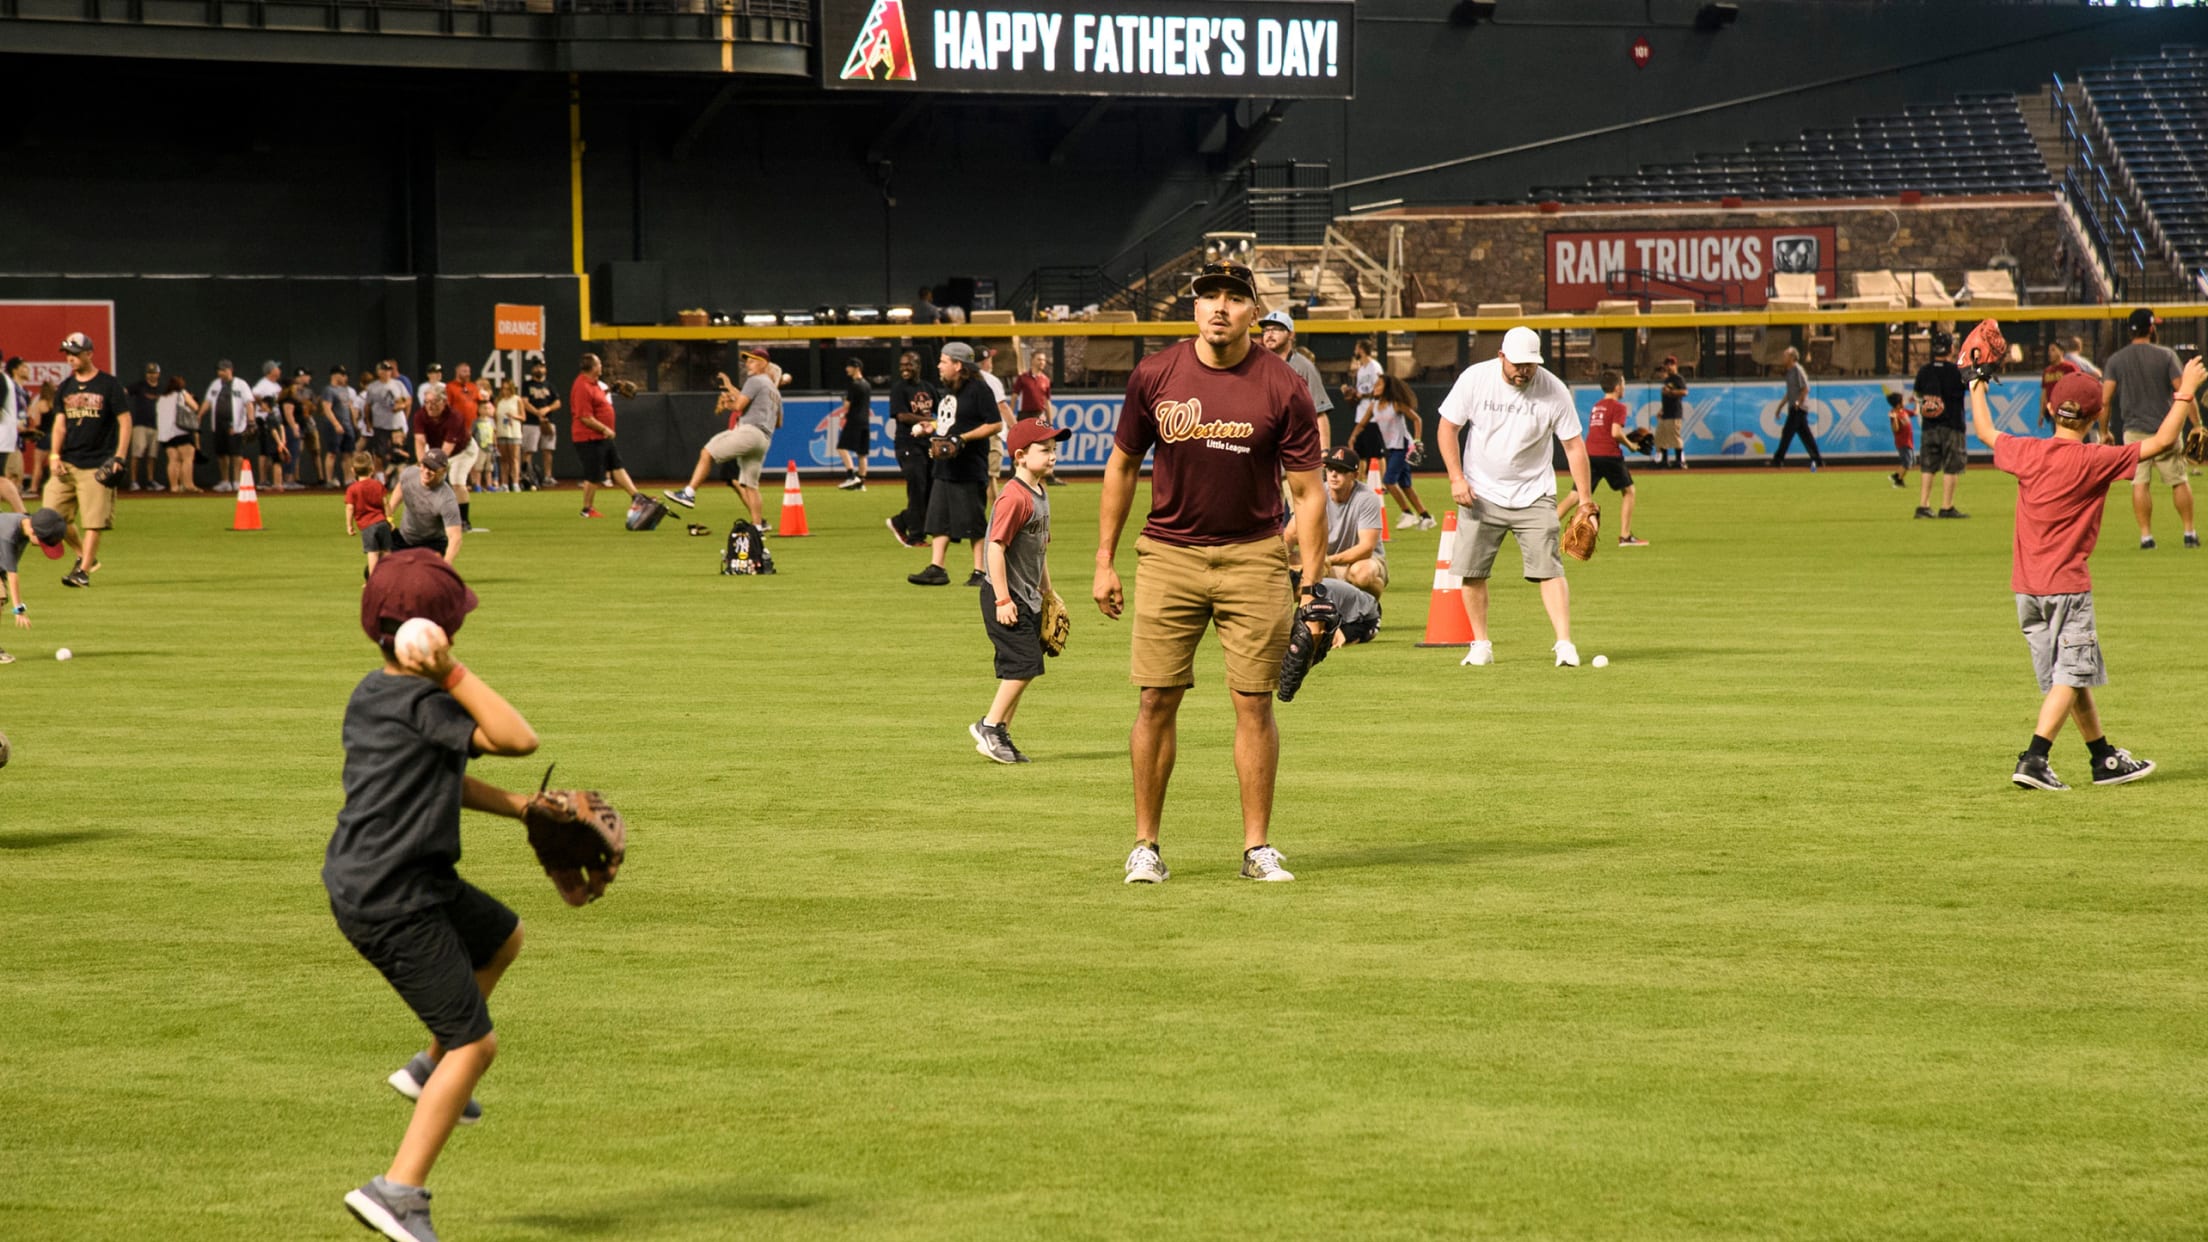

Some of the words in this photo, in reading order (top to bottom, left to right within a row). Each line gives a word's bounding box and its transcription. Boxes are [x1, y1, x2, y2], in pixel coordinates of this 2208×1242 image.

[933, 9, 1062, 72] HAPPY
[1073, 13, 1246, 77] FATHER'S
[1257, 17, 1339, 78] DAY!
[1634, 45, 1649, 58] 101
[1555, 240, 1626, 285] RAM
[1635, 236, 1763, 283] TRUCKS
[497, 320, 538, 336] ORANGE
[1483, 400, 1523, 415] Hurley
[1155, 397, 1255, 444] Western
[1206, 439, 1225, 450] Little
[1225, 442, 1251, 454] League
